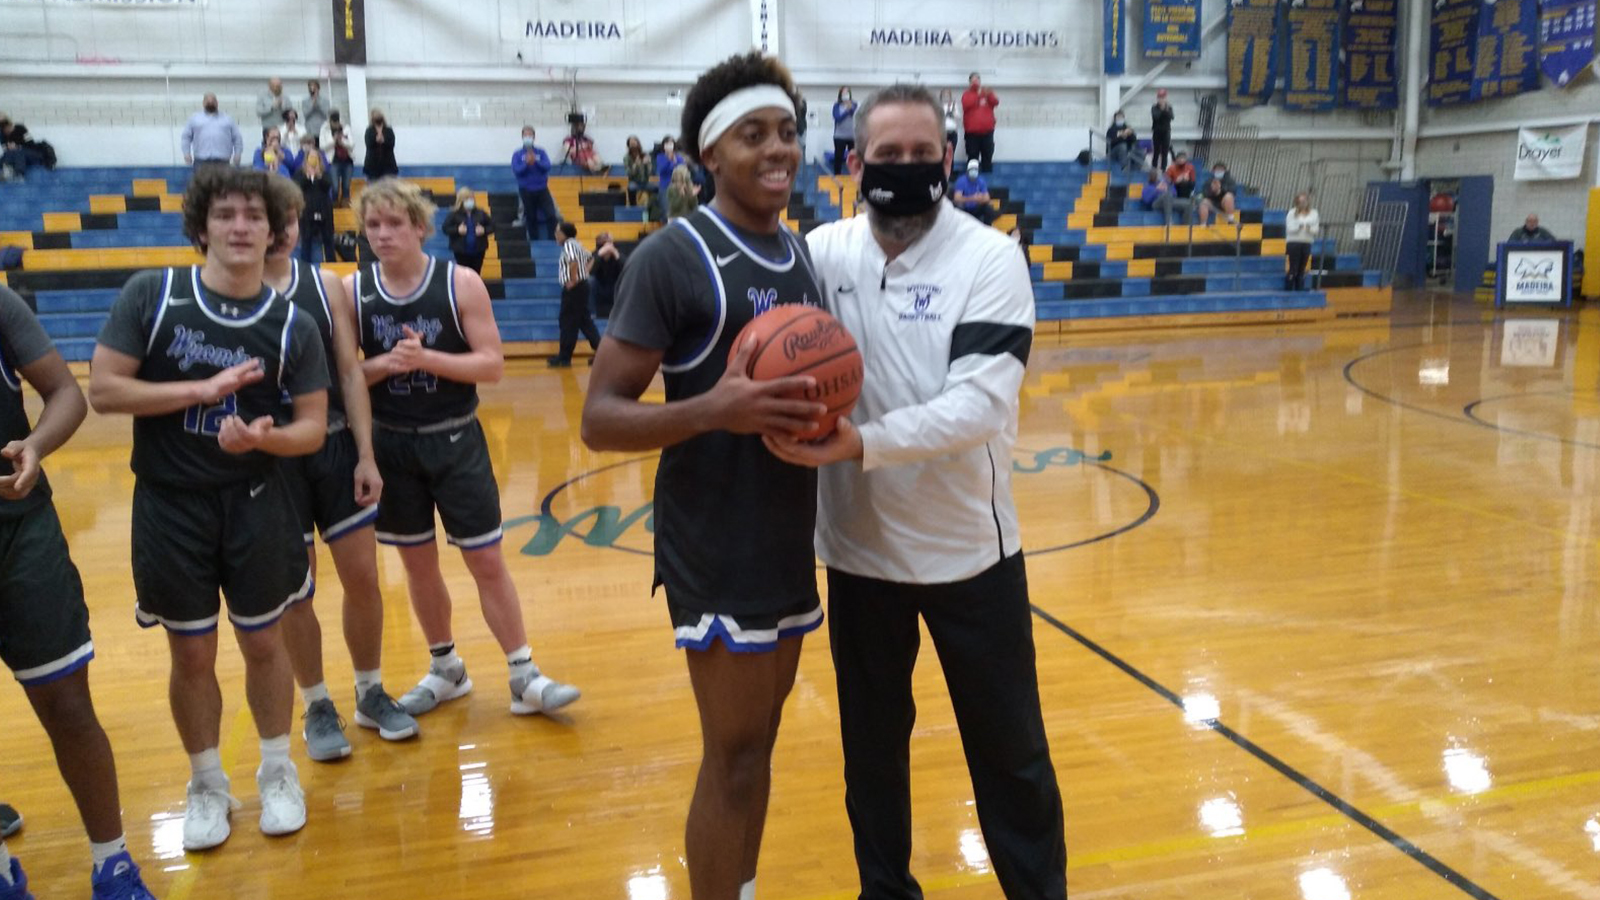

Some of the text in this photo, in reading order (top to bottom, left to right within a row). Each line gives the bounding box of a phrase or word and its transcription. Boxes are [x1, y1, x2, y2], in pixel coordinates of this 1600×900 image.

[525, 20, 621, 39] MADEIRA
[870, 28, 1059, 47] MADEIRA STUDENTS
[1516, 281, 1554, 292] MADEIRA
